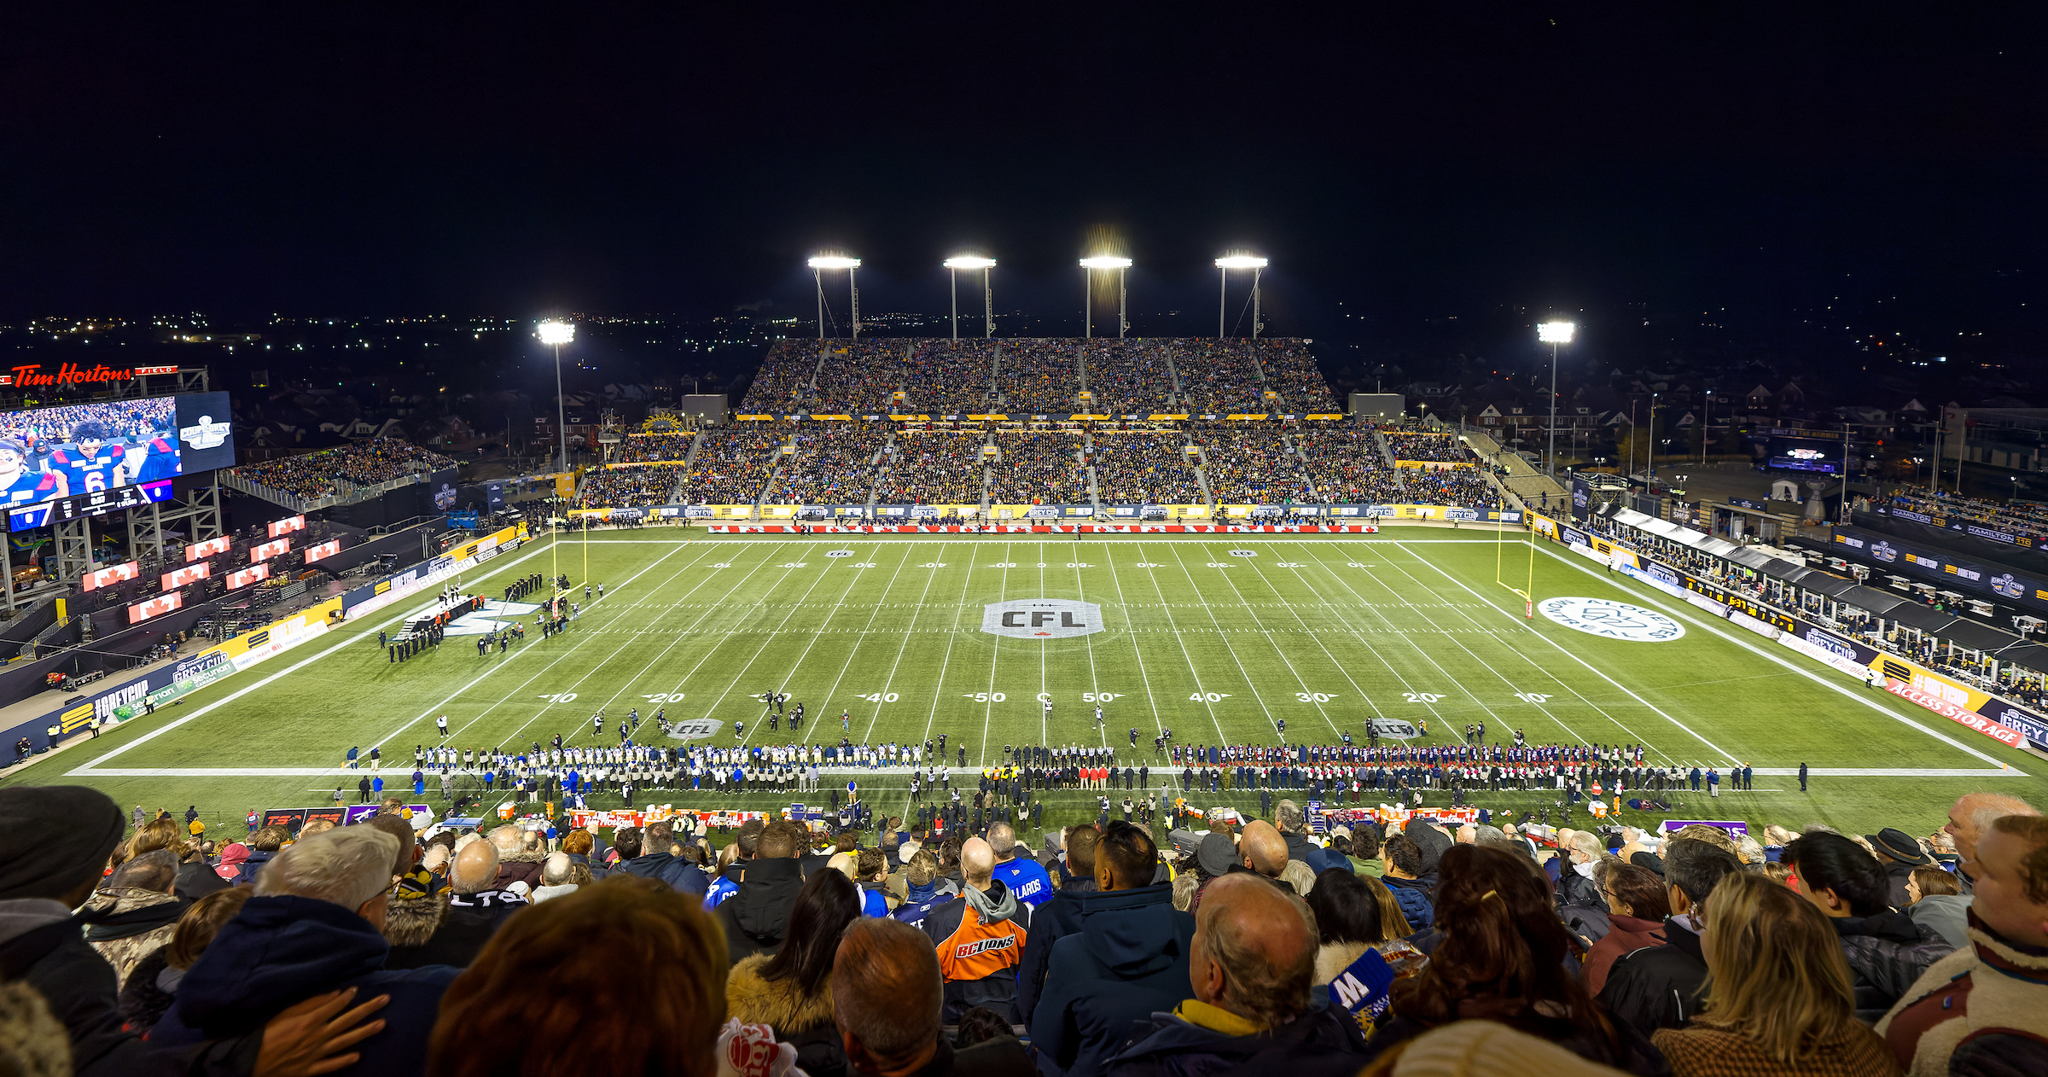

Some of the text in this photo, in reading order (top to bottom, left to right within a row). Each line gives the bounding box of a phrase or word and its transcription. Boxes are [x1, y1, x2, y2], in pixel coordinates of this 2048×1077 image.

[11, 362, 131, 388] Tim Hortons
[141, 367, 172, 375] FIELD
[1968, 525, 2032, 548] HAMILTON 110
[1002, 612, 1085, 627] CFL
[548, 693, 578, 704] 10
[648, 693, 685, 703] 20
[866, 692, 900, 703] 40
[974, 692, 1006, 703] 50
[1082, 692, 1114, 703] 50
[1189, 692, 1222, 703] 40
[1295, 692, 1330, 703] 30
[1402, 692, 1438, 703] 20
[1514, 692, 1548, 703] 10
[1888, 681, 2018, 744] ACCESS STORAGE
[677, 725, 710, 734] CFL
